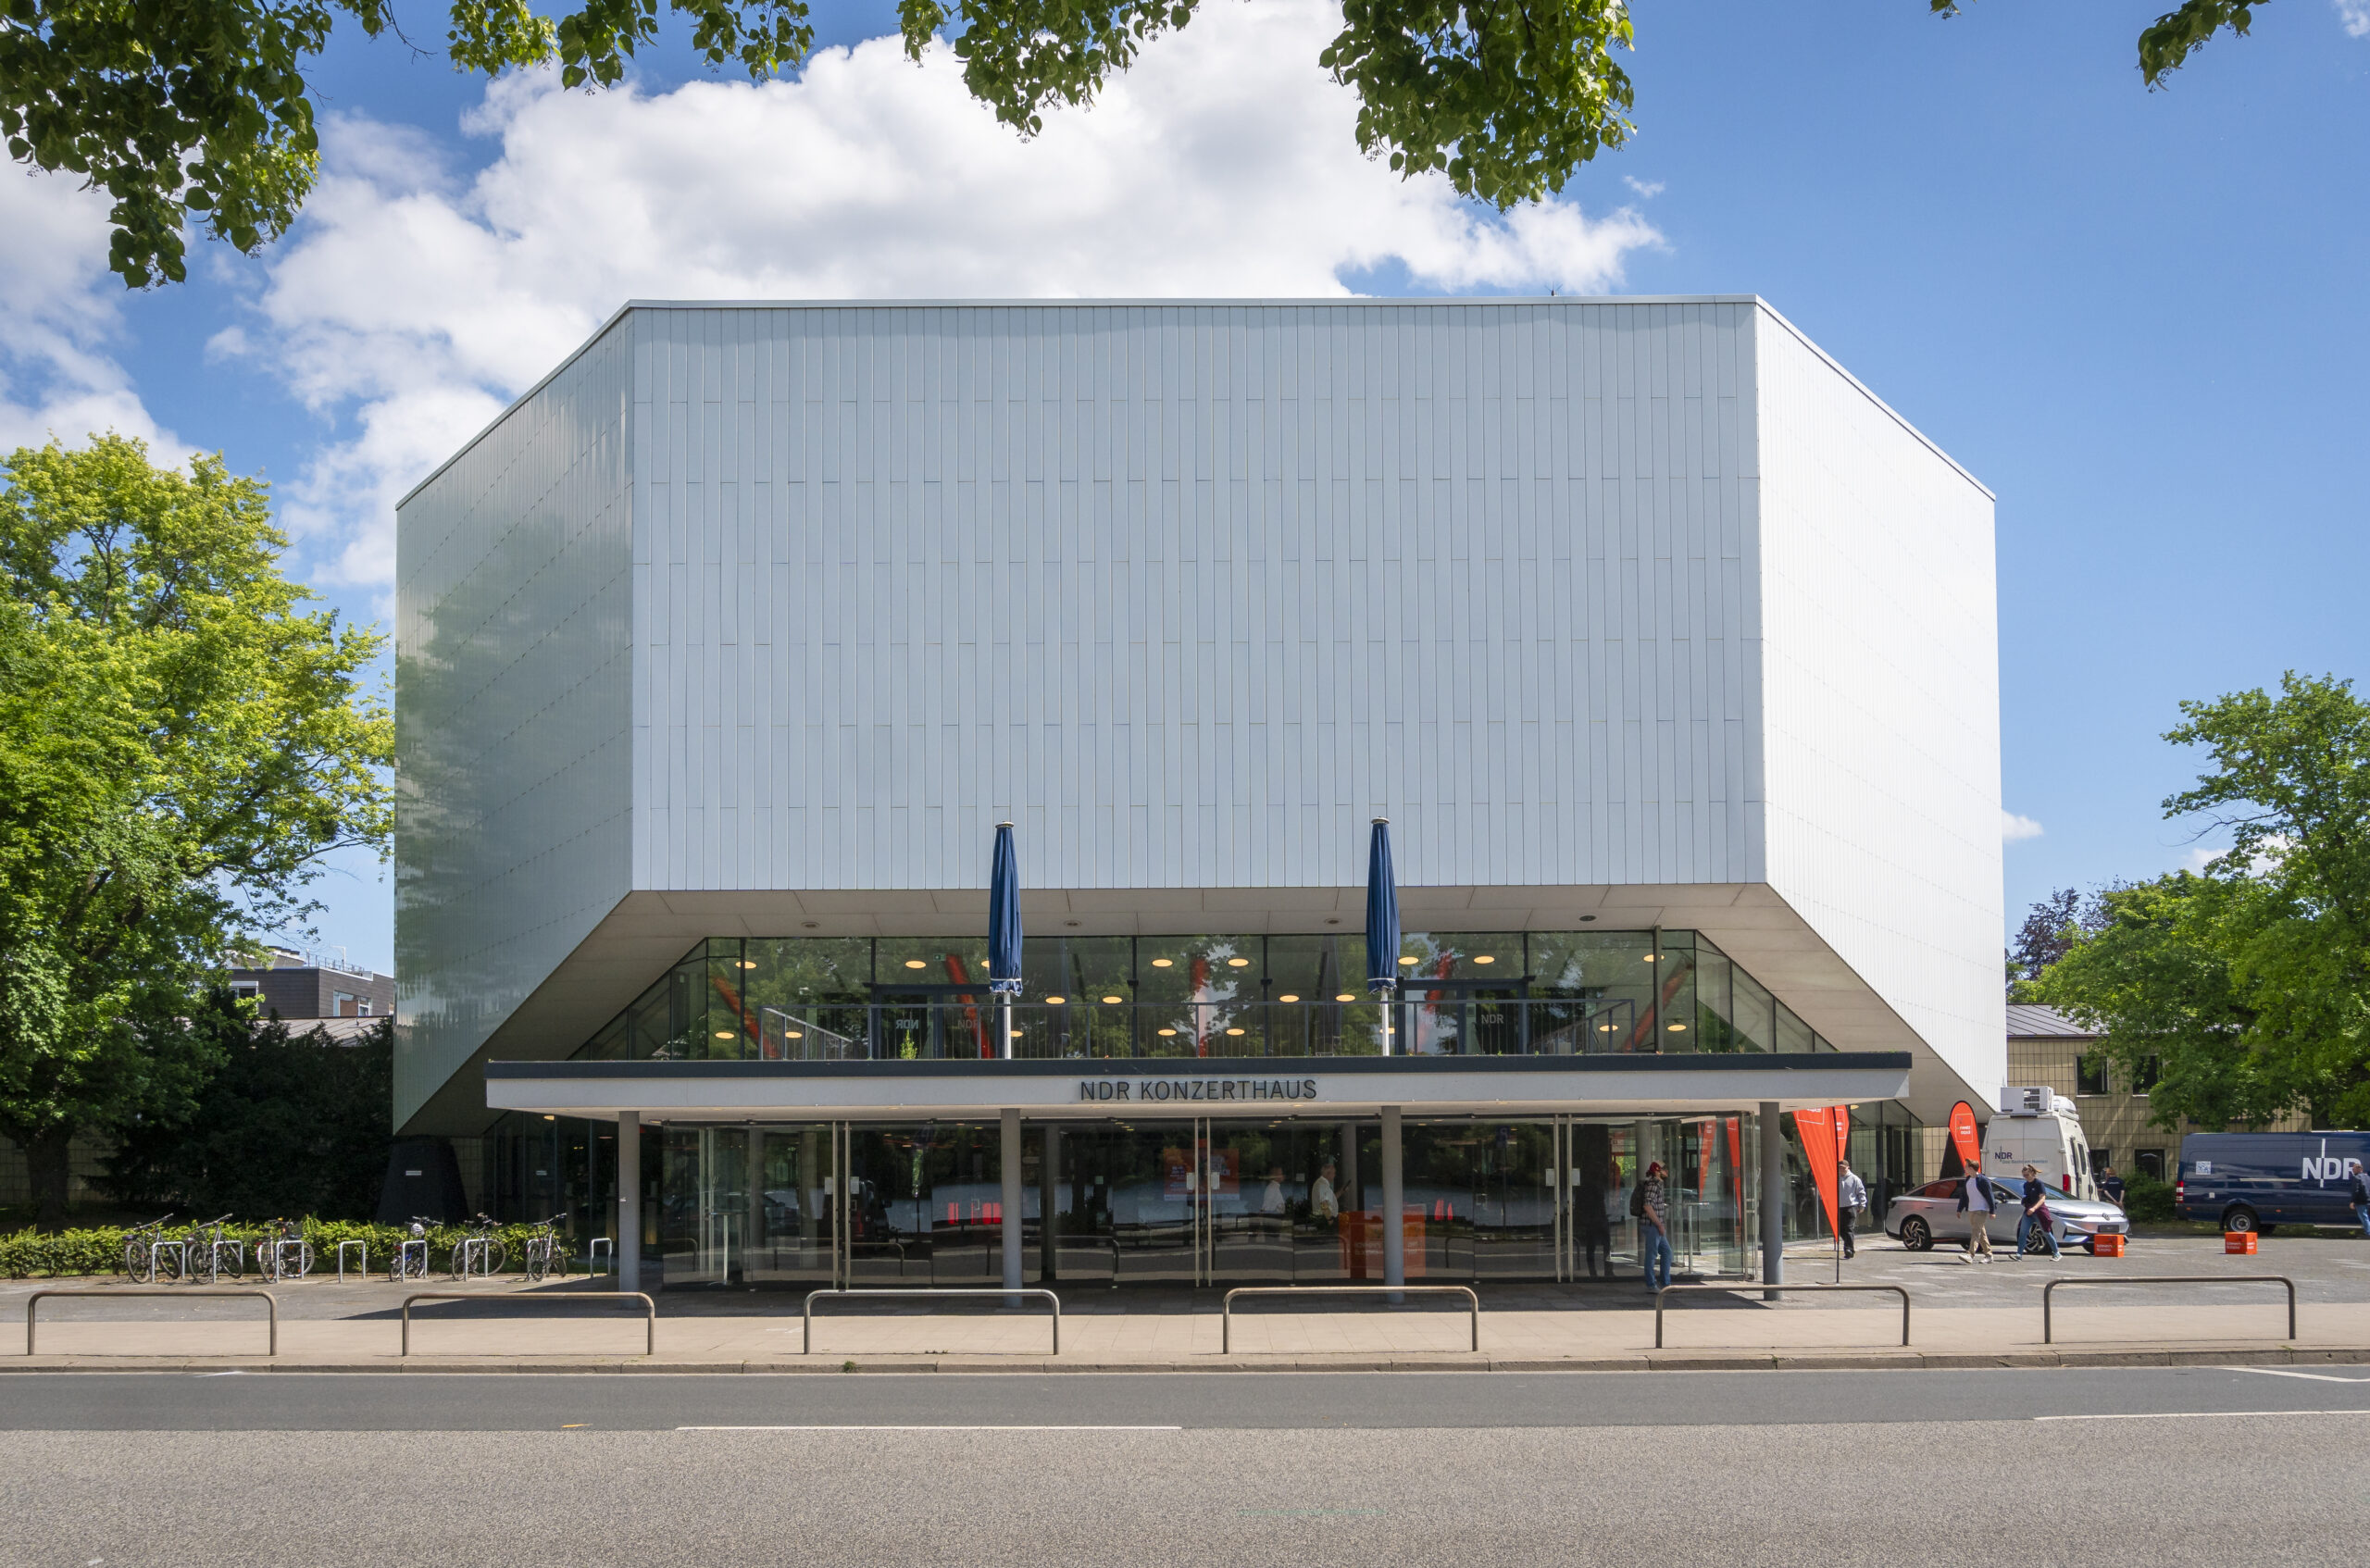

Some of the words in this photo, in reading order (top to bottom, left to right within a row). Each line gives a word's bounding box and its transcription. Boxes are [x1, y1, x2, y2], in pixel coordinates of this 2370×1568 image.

[1481, 1014, 1504, 1025] NDR
[1080, 1080, 1130, 1101] NDR
[1141, 1079, 1317, 1100] KONZERTHAUS
